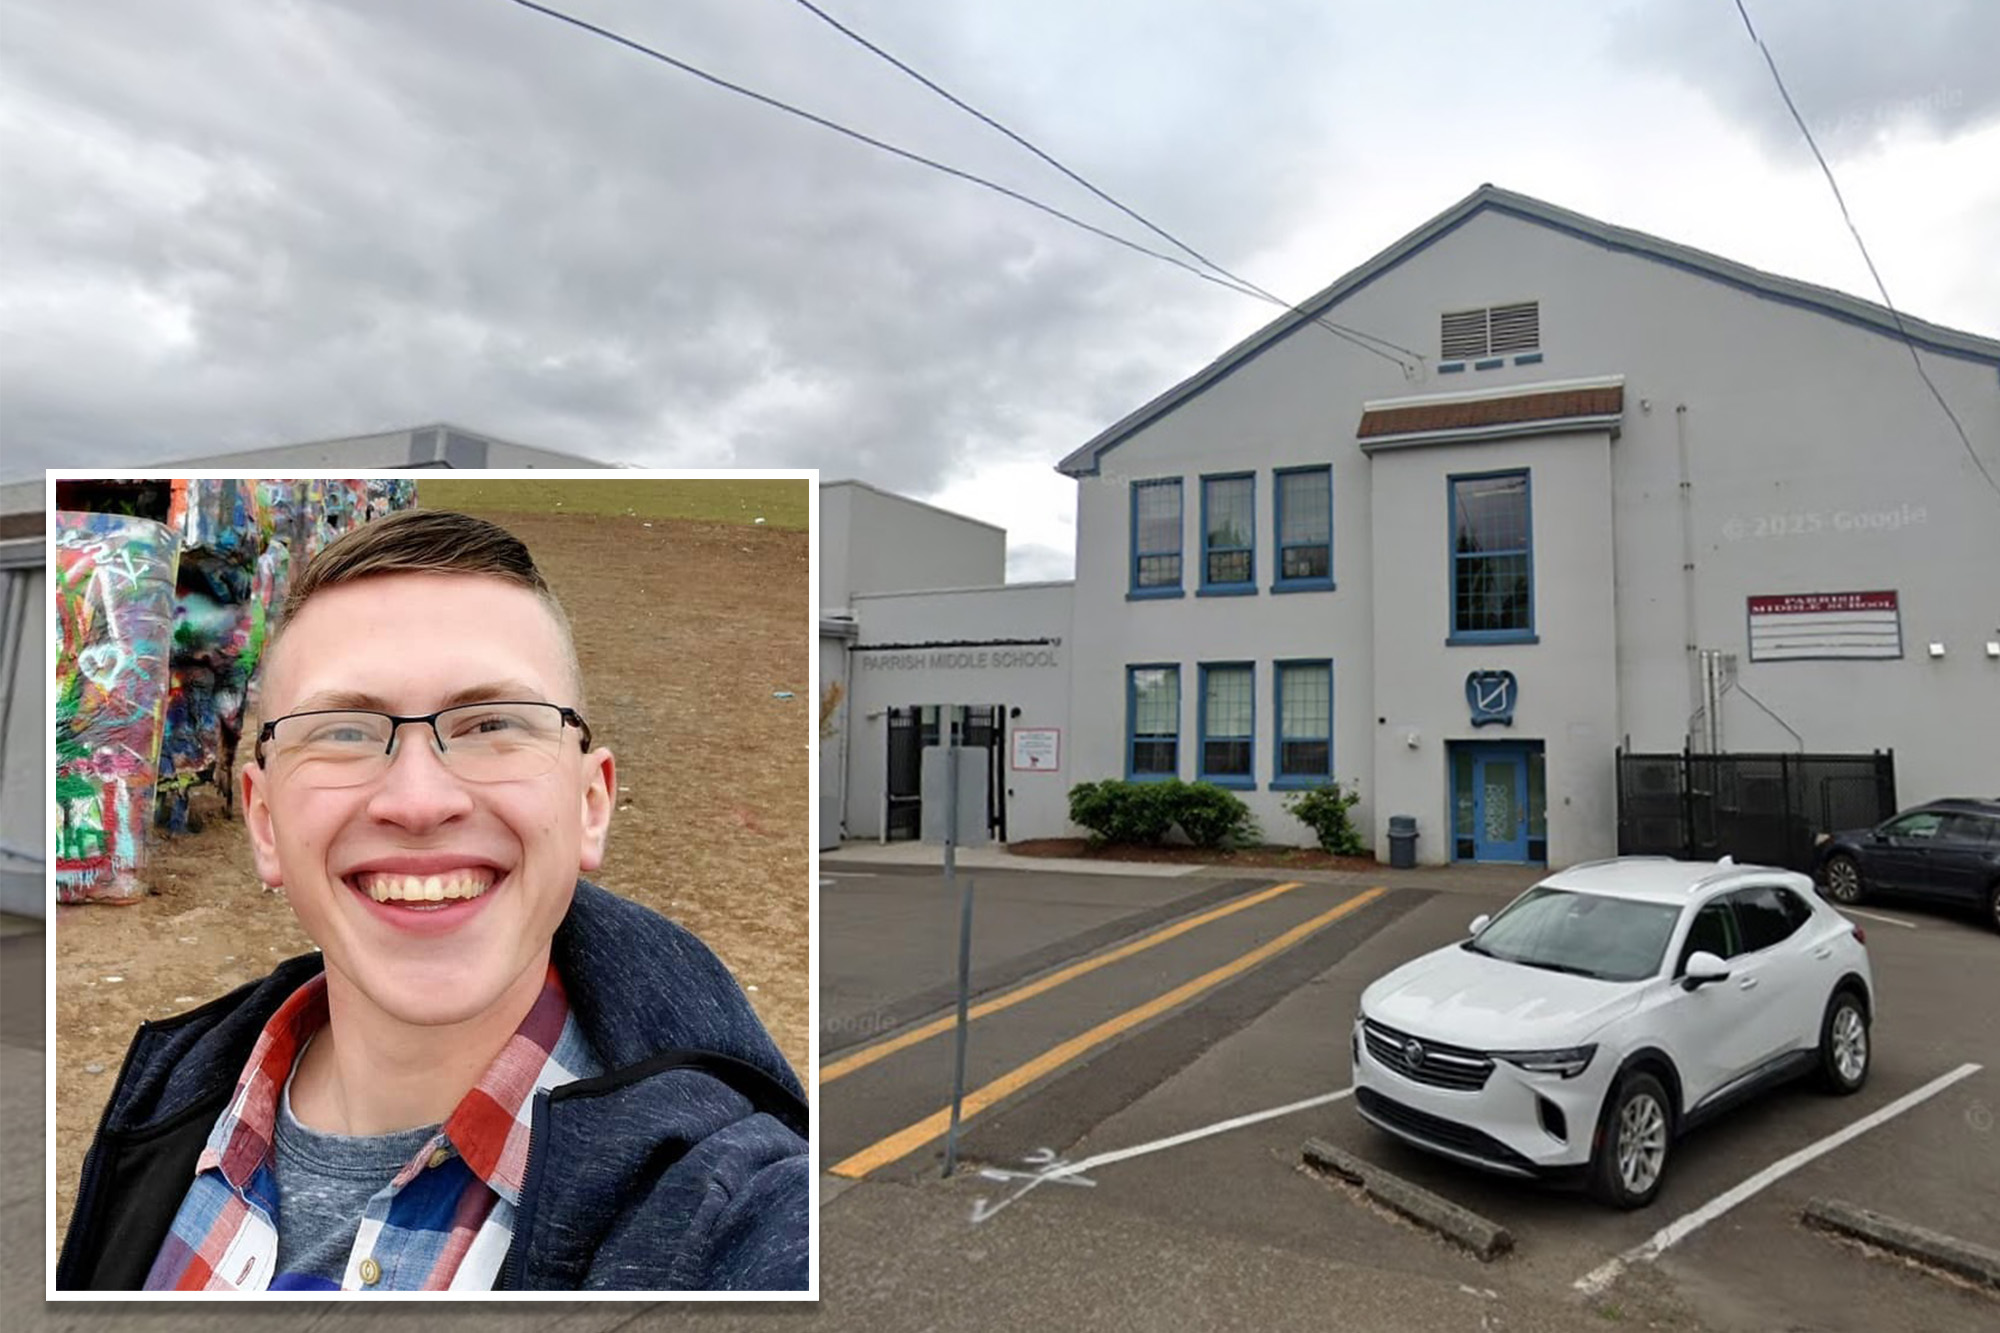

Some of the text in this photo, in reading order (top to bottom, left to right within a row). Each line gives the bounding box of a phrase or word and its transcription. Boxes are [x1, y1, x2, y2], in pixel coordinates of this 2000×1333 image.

[1751, 600, 1896, 613] MIDDLE SCHOOL
[862, 651, 1059, 671] PARRISH MIDDLE SCHOOL
